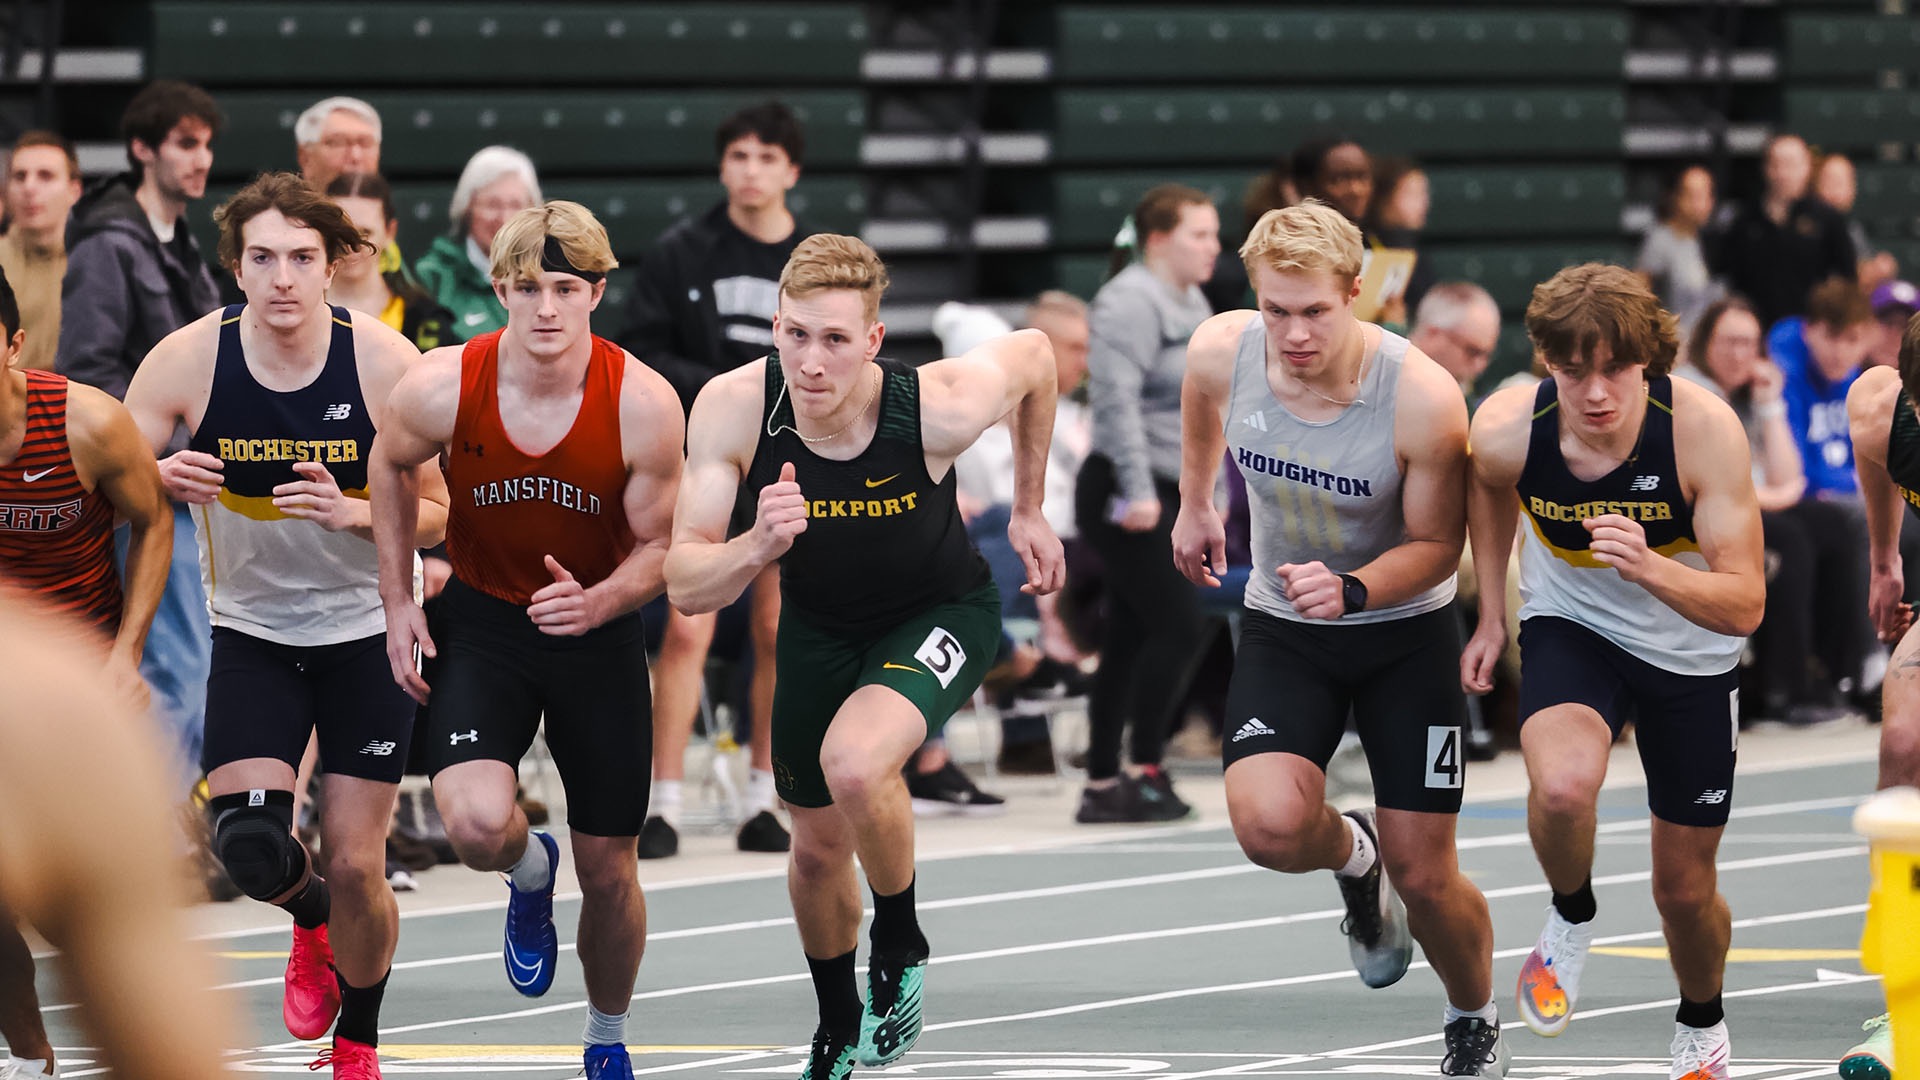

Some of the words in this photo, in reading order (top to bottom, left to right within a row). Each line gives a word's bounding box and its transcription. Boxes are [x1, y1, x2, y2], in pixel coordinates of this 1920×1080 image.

[218, 438, 359, 462] ROCHESTER
[1239, 447, 1372, 497] HOUGHTON
[473, 476, 600, 515] MANSFIELD
[1530, 495, 1673, 522] ROCHESTER
[925, 634, 960, 673] 5
[1232, 728, 1276, 742] adidas
[1433, 730, 1458, 785] 4
